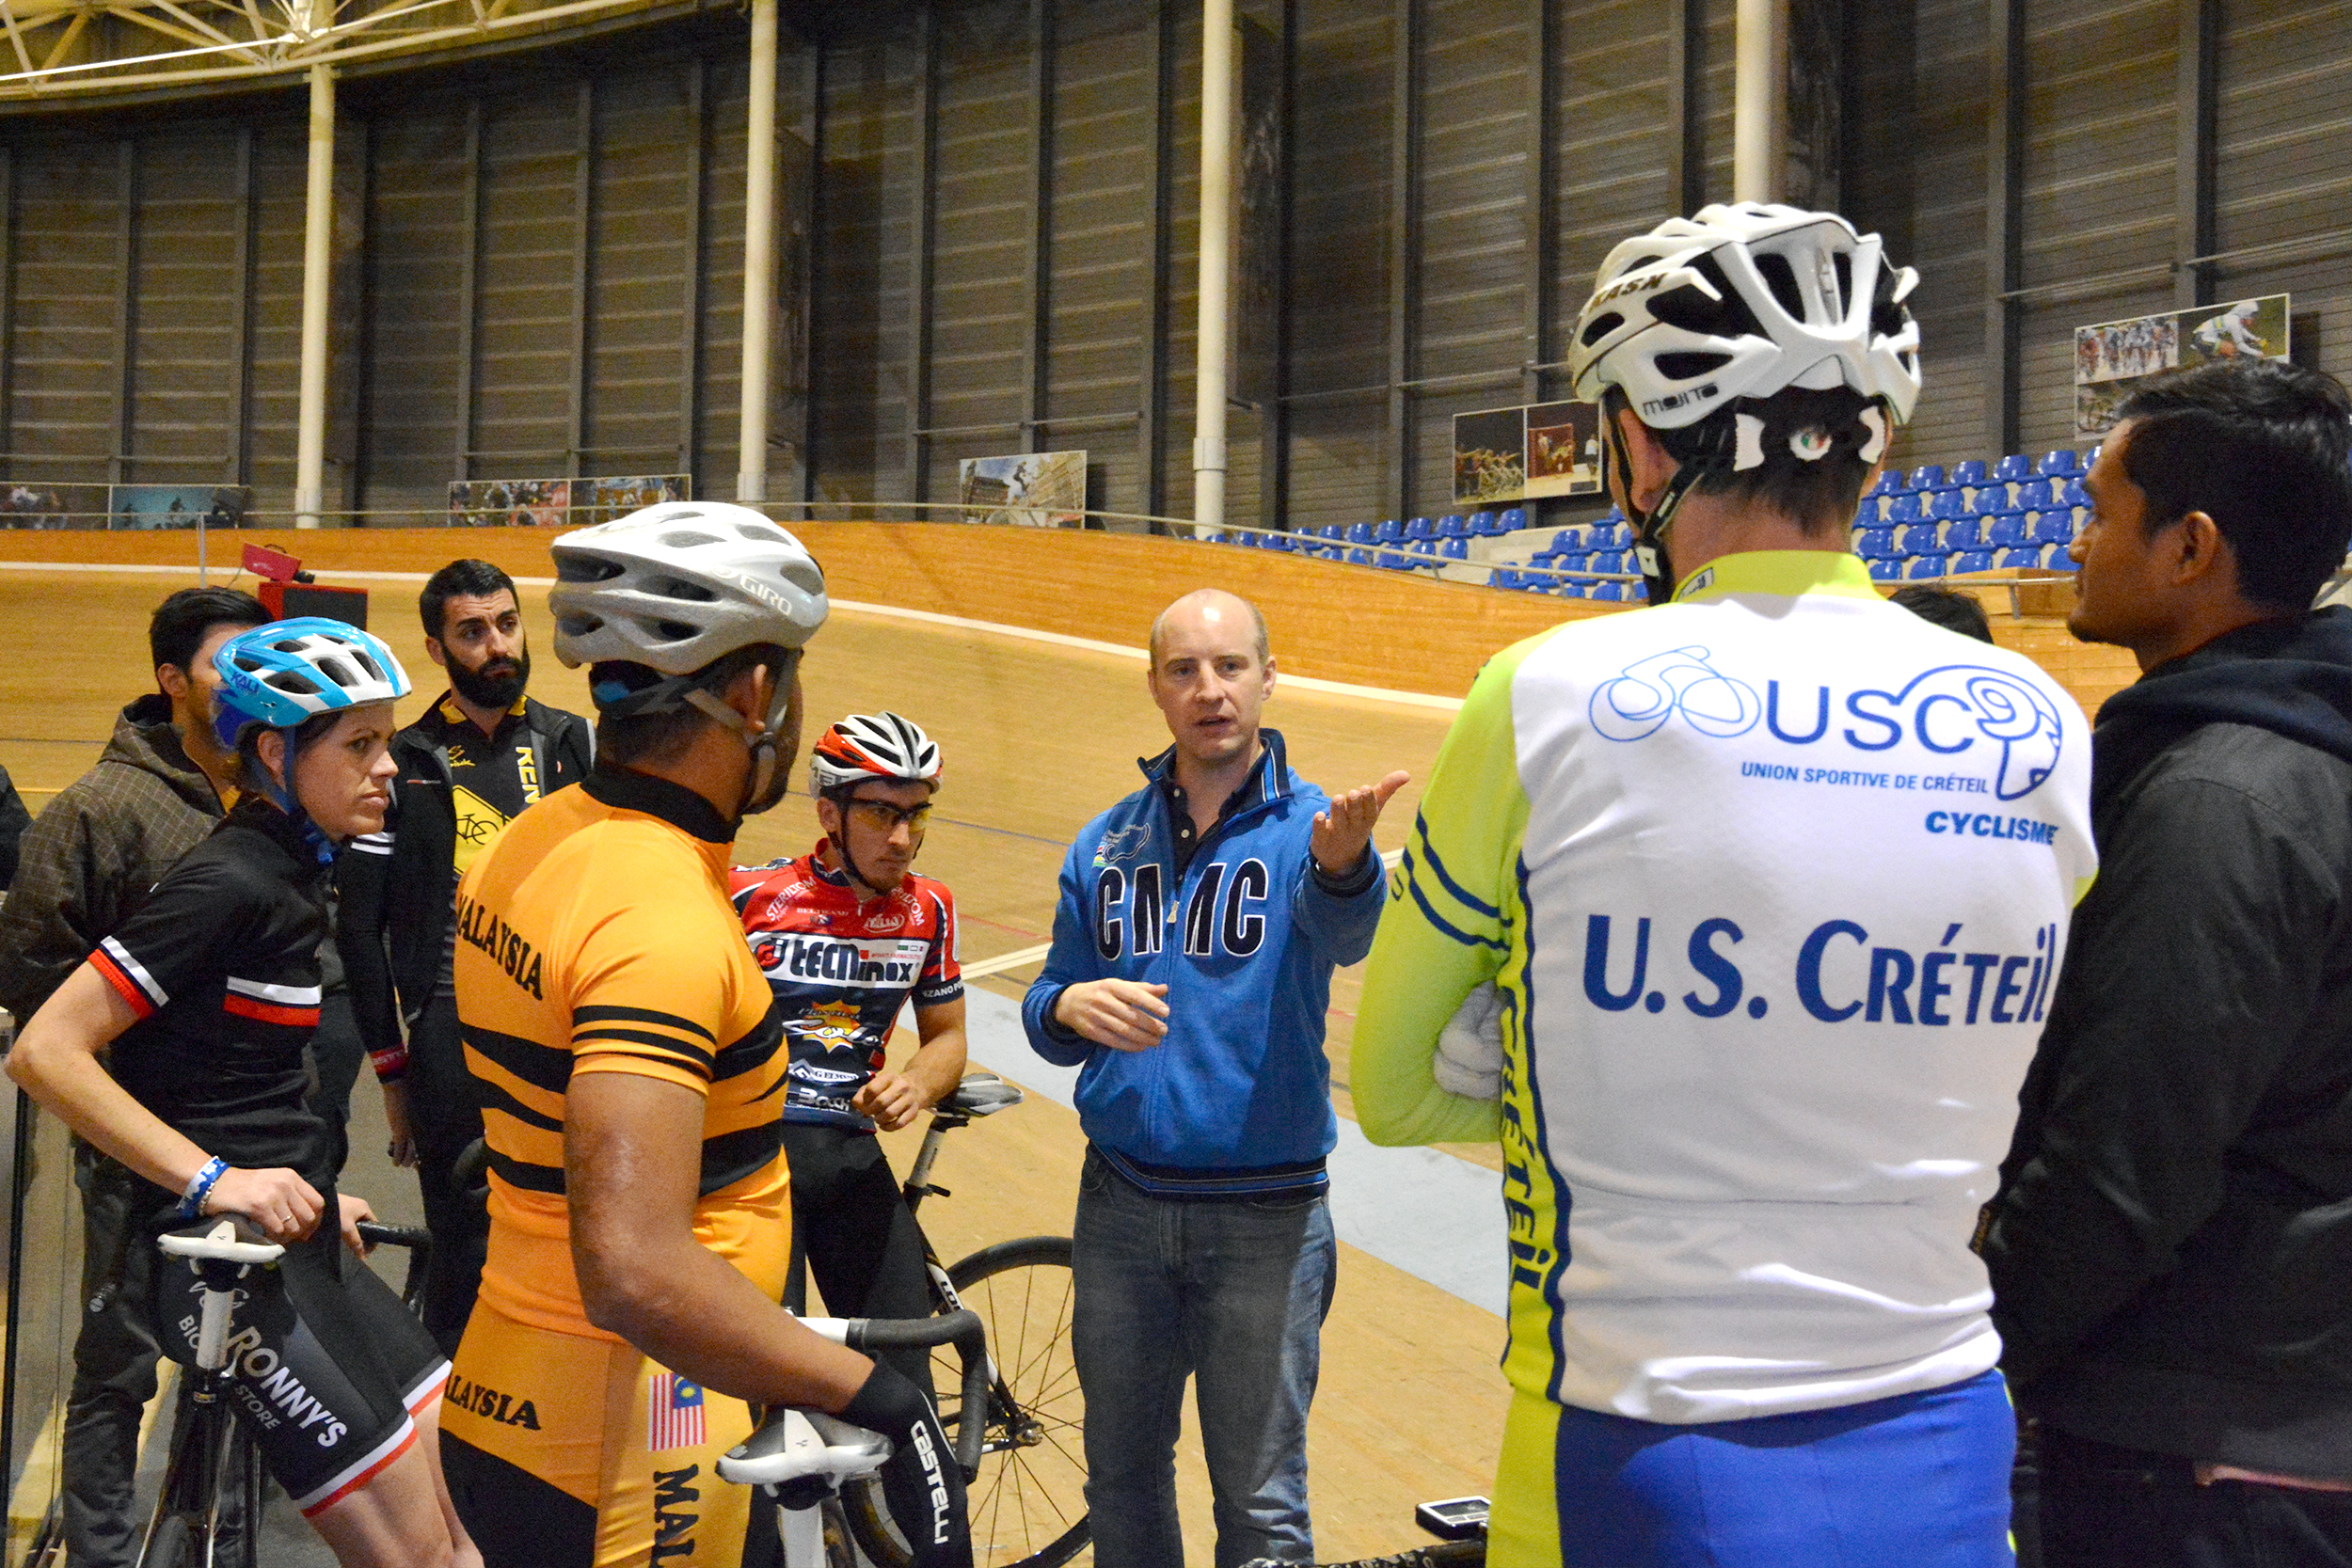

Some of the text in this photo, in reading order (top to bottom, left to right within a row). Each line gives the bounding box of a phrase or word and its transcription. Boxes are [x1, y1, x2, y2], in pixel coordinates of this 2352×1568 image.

[739, 573, 793, 617] GIRO
[230, 670, 260, 694] KALI
[1741, 761, 1989, 794] UNION SPORTIVE DE CRÉTEIL
[1925, 811, 2058, 846] CYCLISME
[766, 876, 818, 922] STERILTOM
[1583, 914, 1769, 1020] U.S.
[226, 1325, 348, 1448] RONNY'S
[236, 1384, 281, 1430] STORE
[910, 1419, 950, 1544] CASTELLI
